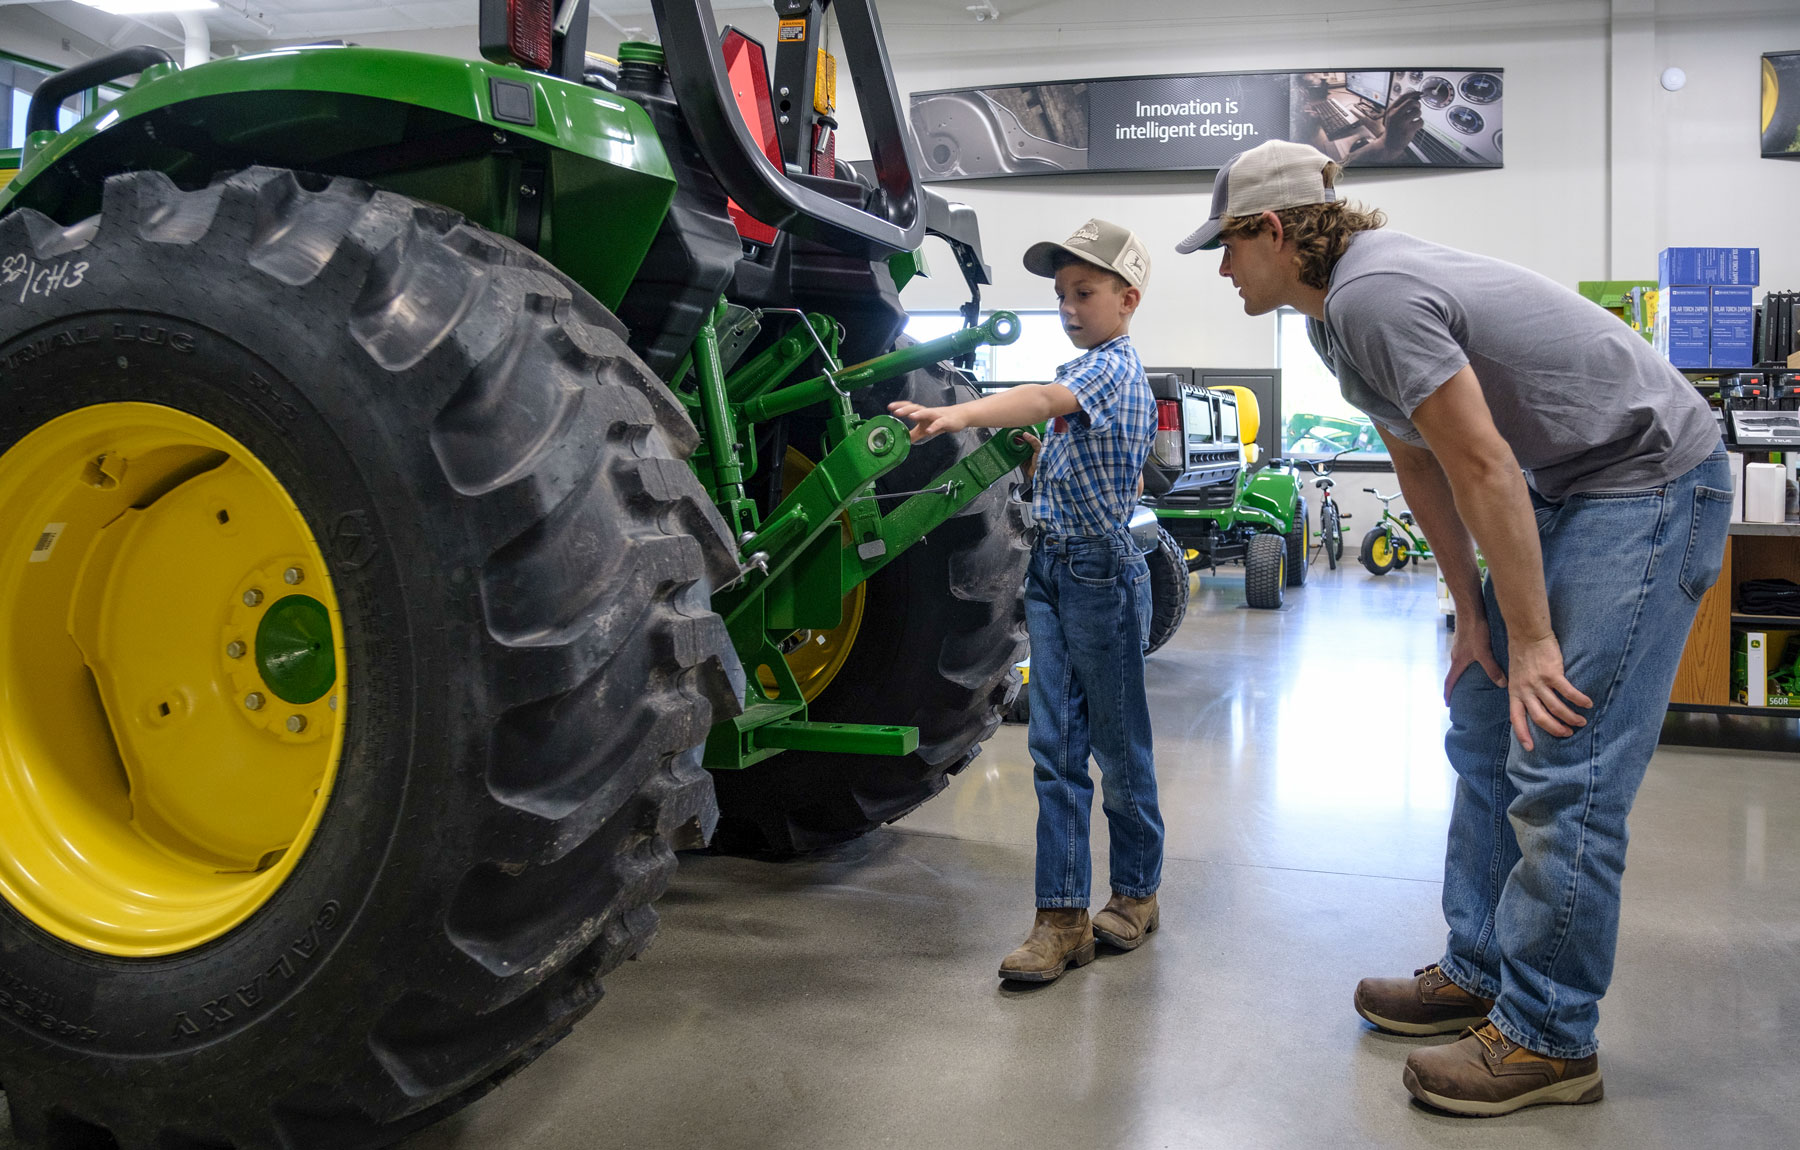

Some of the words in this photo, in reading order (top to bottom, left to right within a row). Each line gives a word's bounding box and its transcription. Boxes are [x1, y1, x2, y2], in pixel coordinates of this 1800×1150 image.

[1136, 98, 1221, 117] Innovation
[1225, 97, 1239, 114] is
[1115, 121, 1196, 143] intelligent
[1199, 119, 1259, 141] design.
[113, 322, 197, 354] LUG
[169, 899, 342, 1041] GALAXY
